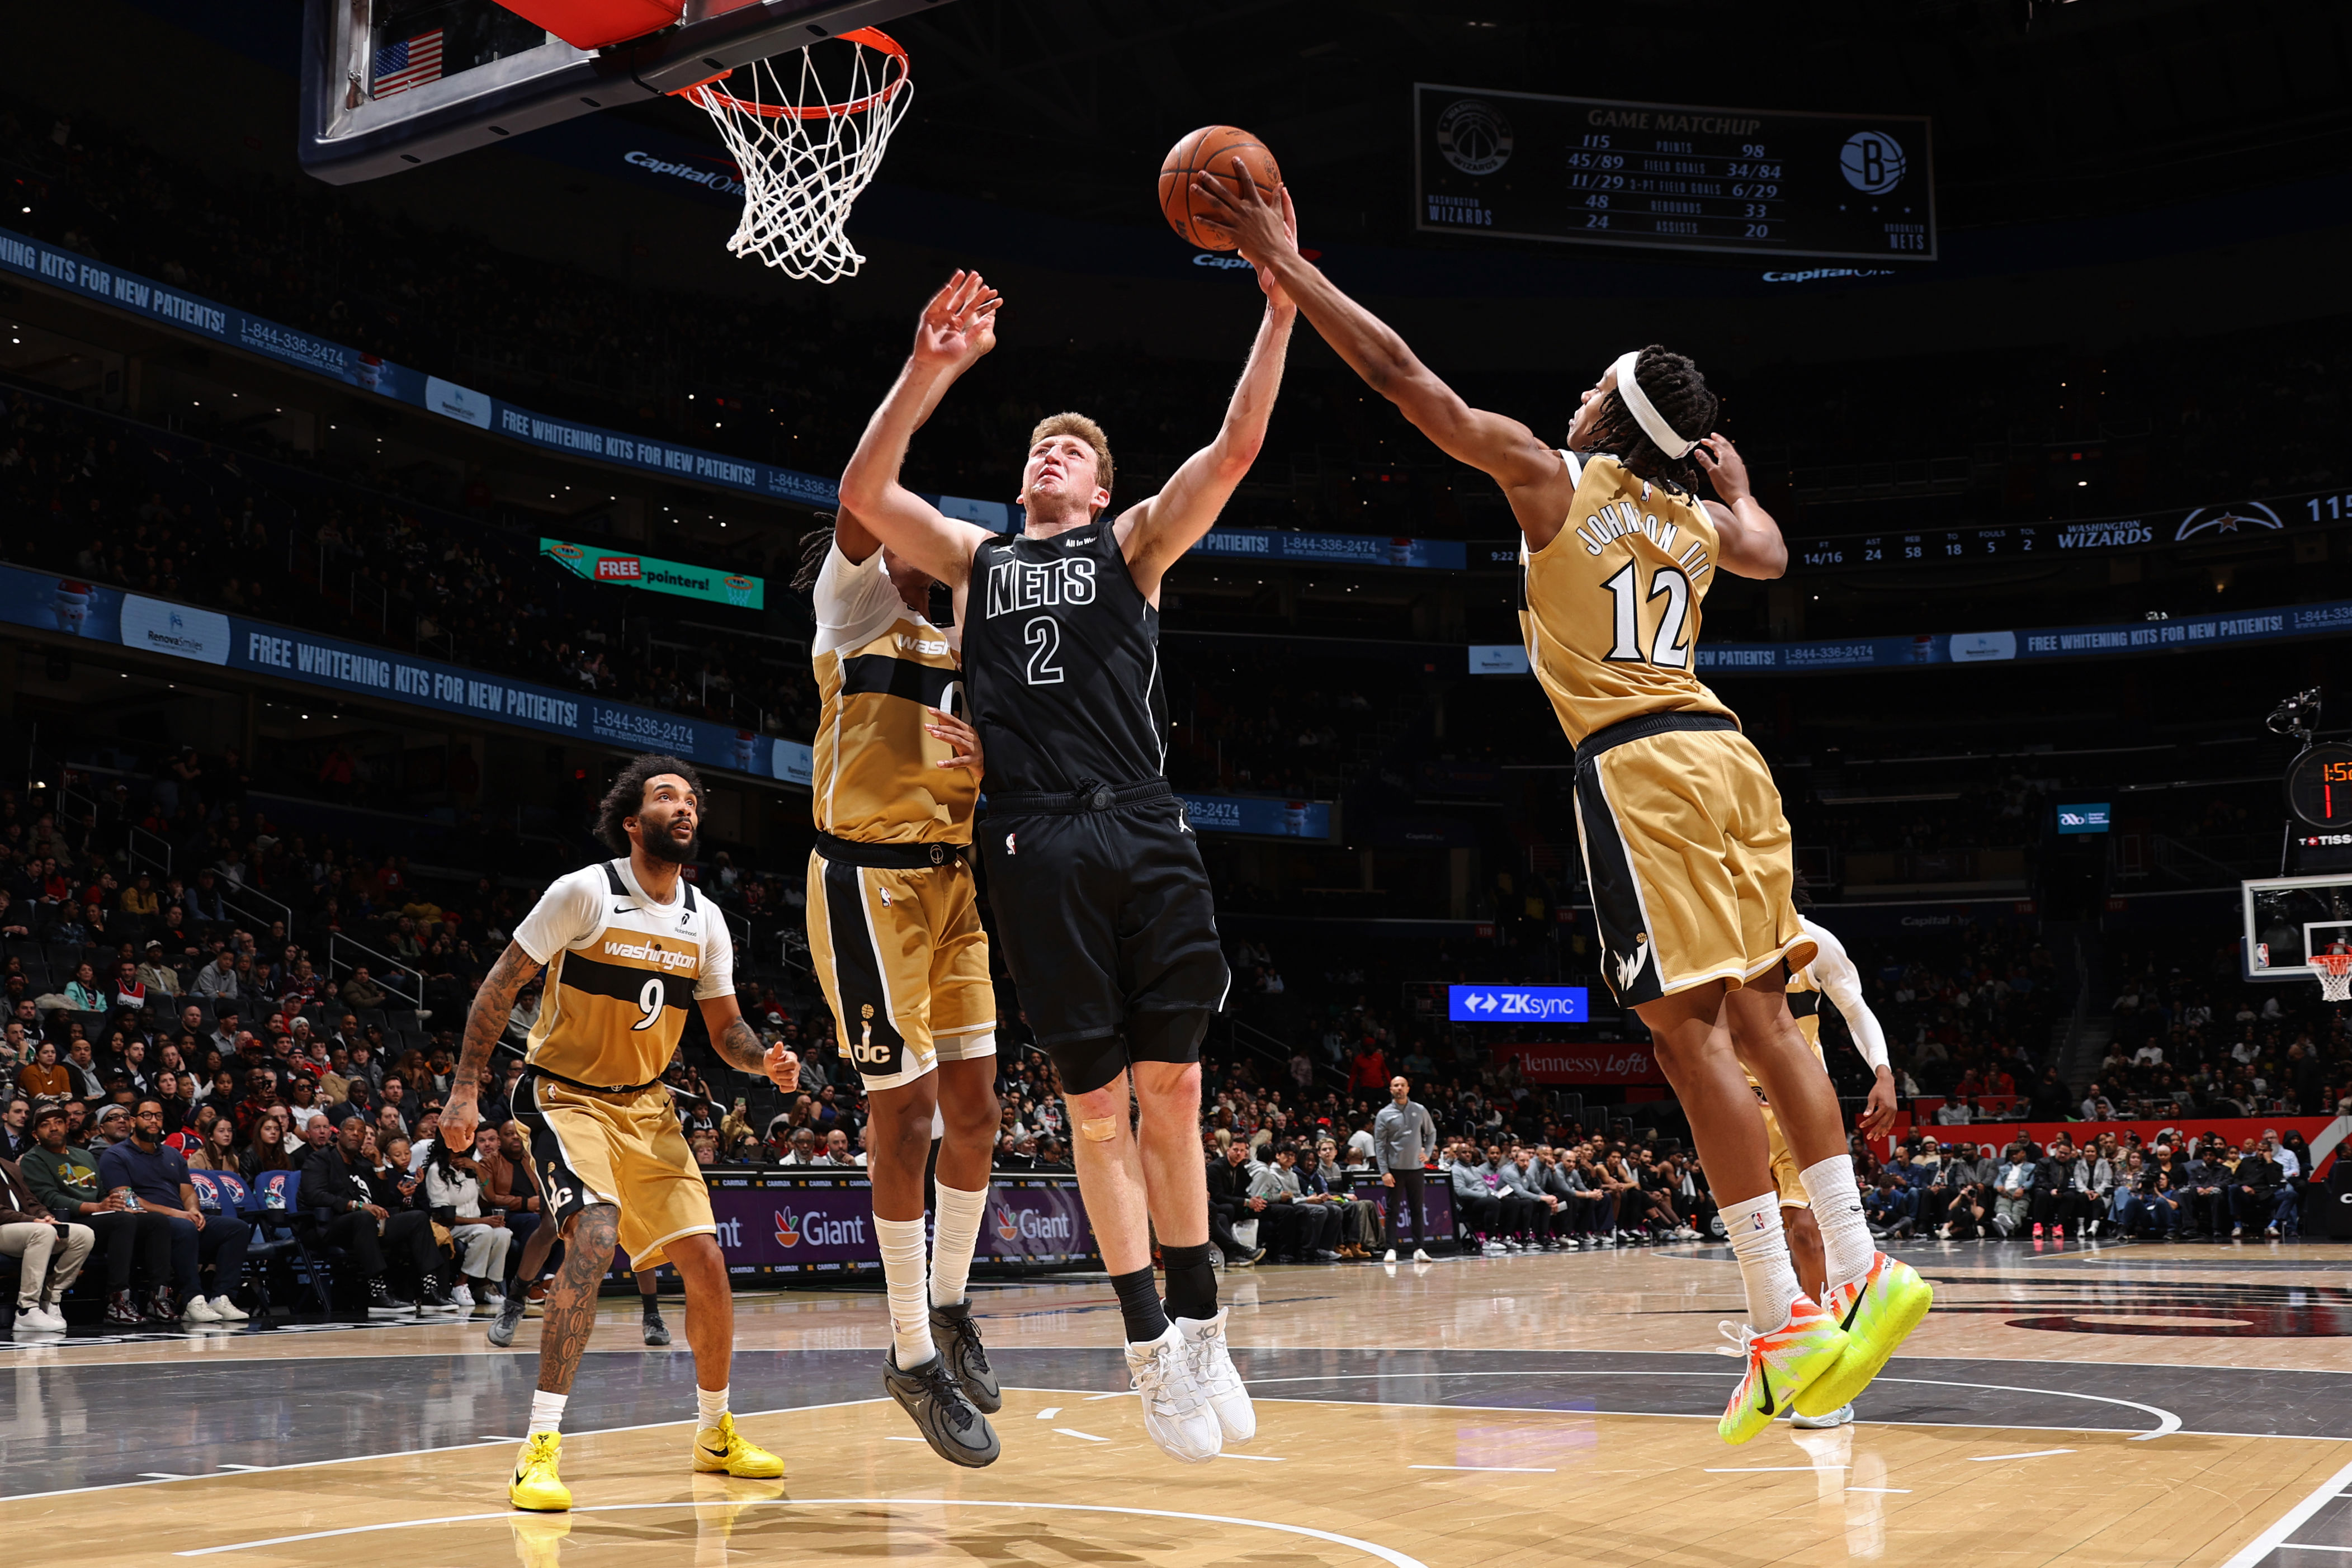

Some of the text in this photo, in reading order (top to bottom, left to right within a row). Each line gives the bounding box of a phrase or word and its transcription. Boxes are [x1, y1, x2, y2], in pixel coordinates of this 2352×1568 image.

[1588, 109, 1761, 136] GAME MATCHUP
[1582, 134, 1765, 158] 115 POINTS 98
[1568, 152, 1782, 179] 45/89 FIELD GOALS 34/84
[1572, 173, 1778, 198] 11/29 3-PT FIELD GOALS 6/29
[1428, 195, 1480, 207] WASHINGTON
[1585, 194, 1767, 219] 48 REBOUNDS 33
[1429, 205, 1492, 225] WIZARDS
[1586, 214, 1769, 238] 24 ASSISTS 20
[1890, 234, 1924, 251] NETS
[40, 250, 75, 284] KITS
[79, 264, 111, 294] FOR
[114, 277, 150, 308] NEW
[153, 289, 225, 334] PATIENTS!
[240, 318, 344, 365] 1-844-336-2474
[502, 409, 530, 436] FREE
[532, 419, 602, 454] WHITENING
[606, 436, 634, 460] KITS
[637, 443, 662, 466] FOR
[664, 449, 692, 474] NEW
[697, 455, 756, 487] PATIENTS!
[1865, 537, 1881, 546] AST
[1947, 532, 1959, 541] TO
[1978, 529, 2006, 539] FOULS
[2057, 526, 2153, 549] WIZARDS
[2067, 519, 2141, 533] WASHINGTON
[1066, 539, 1076, 547] All
[1208, 533, 1269, 553] PATIENTS!
[1803, 539, 2033, 565] 14/16 24 58 18 5 2
[599, 560, 639, 577] FREE
[1491, 551, 1514, 561] 9:22
[1678, 540, 1710, 582] III
[986, 558, 1096, 620] NETS
[1599, 556, 1691, 669] 12
[147, 630, 203, 652] RenovaSmiles
[2028, 635, 2057, 651] FREE
[2061, 632, 2128, 649] WHITENING
[2131, 629, 2158, 646] KITS
[2161, 626, 2185, 643] FOR
[2188, 622, 2216, 640] NEW
[2219, 615, 2283, 636] PATIENTS!
[1024, 616, 1065, 686] 2
[1718, 650, 1775, 665] PATIENTS!
[248, 632, 578, 728] FREE WHITENING KITS FOR NEW PATIENTS!
[593, 707, 693, 744] 1-844-336-2474
[682, 867, 696, 879] 120
[674, 927, 697, 937] Robinhood
[604, 940, 697, 970] washington
[630, 976, 665, 1031] 9
[1501, 993, 1574, 1019] ZKsync
[1604, 1052, 1650, 1075] Lofts
[802, 1210, 866, 1246] Giant
[1019, 1208, 1070, 1239] Giant
